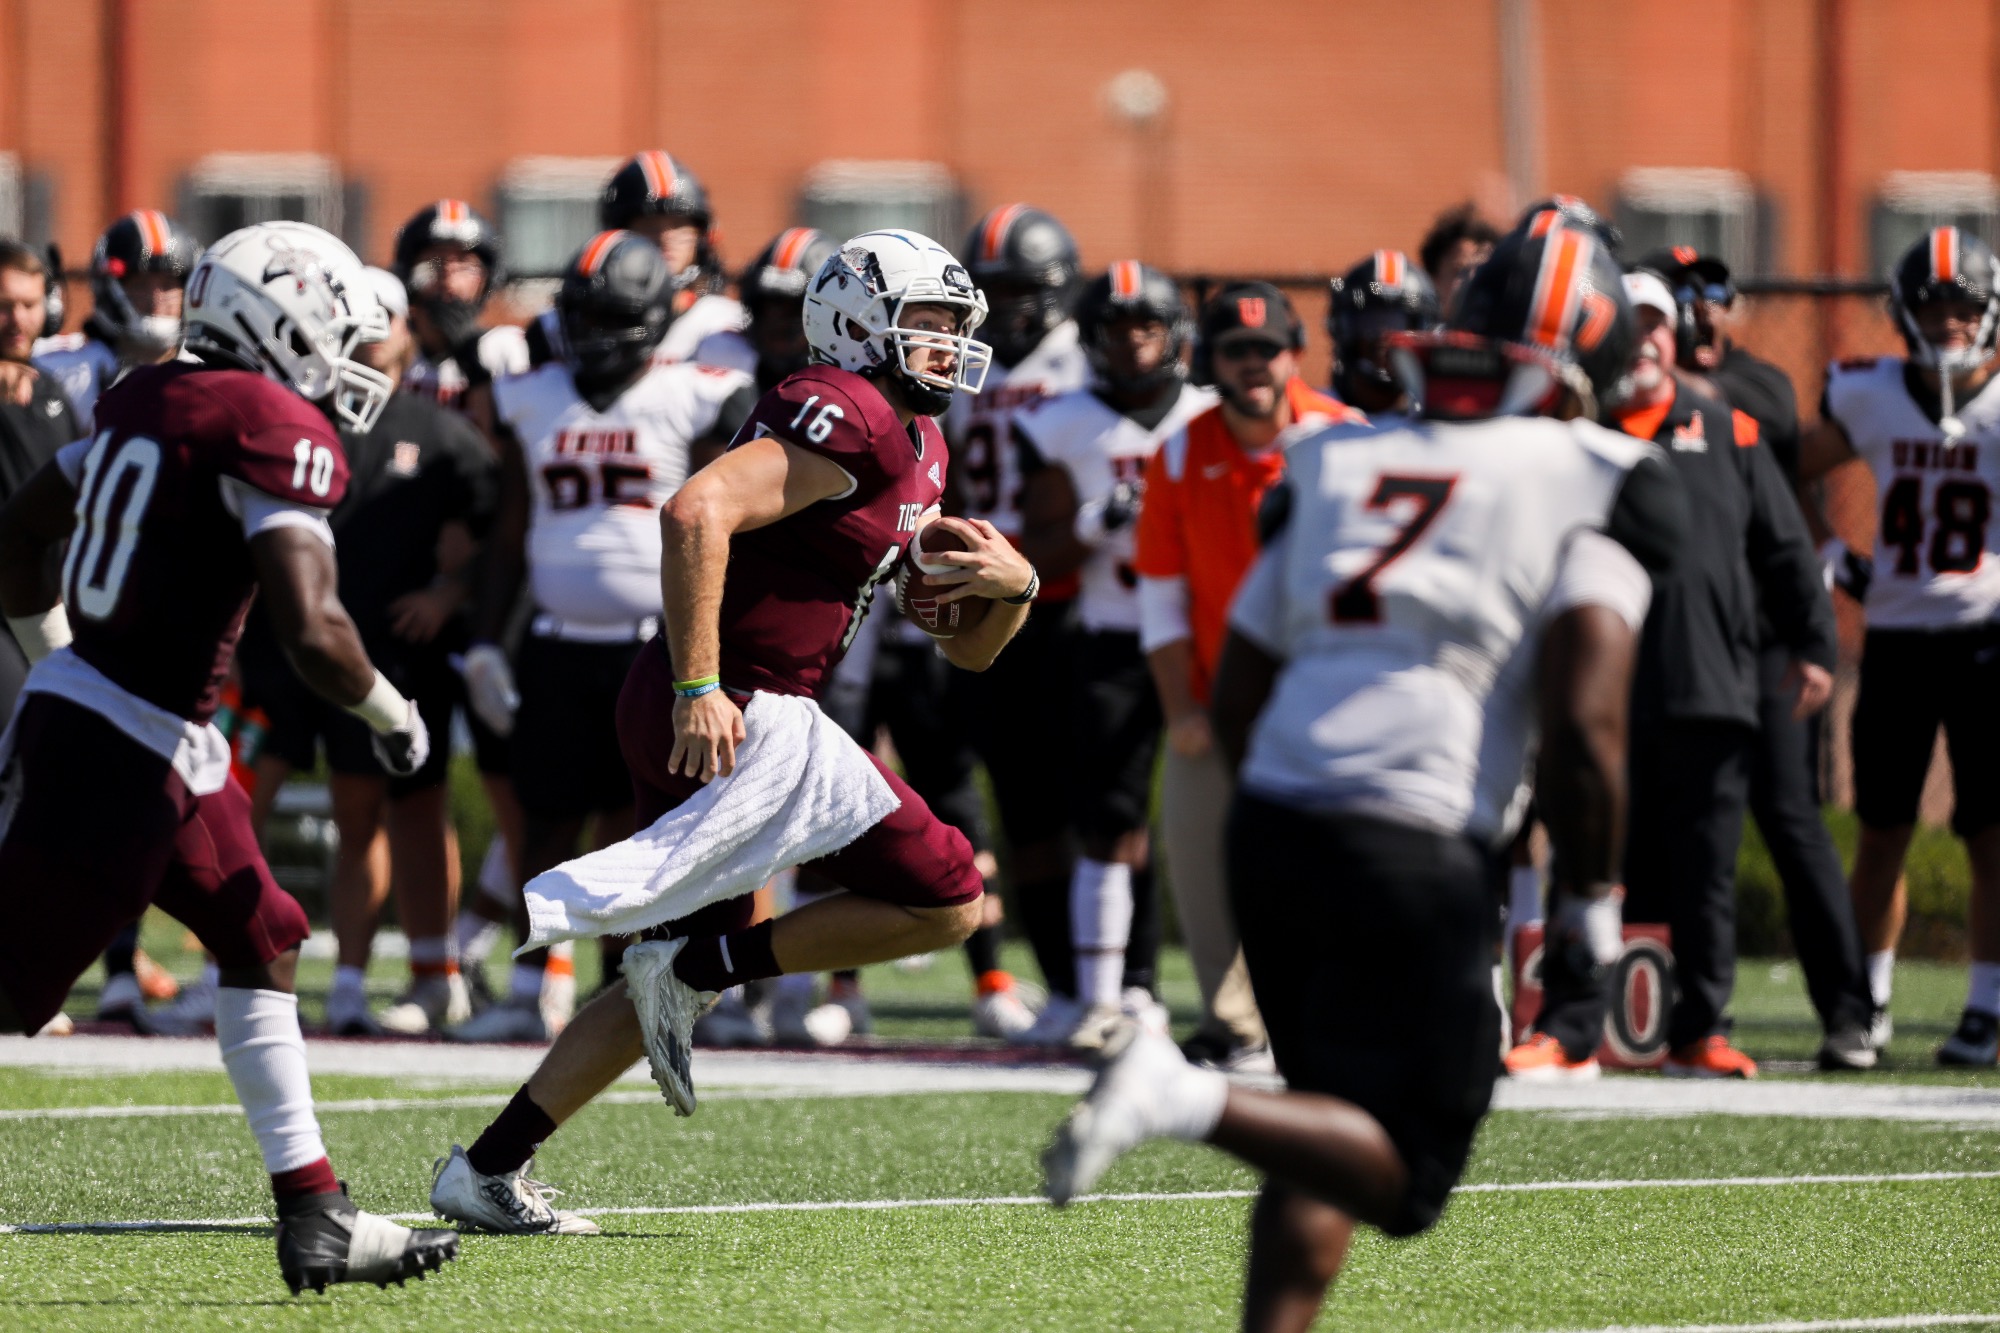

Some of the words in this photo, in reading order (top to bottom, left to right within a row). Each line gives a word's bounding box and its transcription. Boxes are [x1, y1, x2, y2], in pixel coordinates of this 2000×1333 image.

[1237, 297, 1266, 329] U
[790, 395, 844, 444] 16
[292, 438, 335, 498] 10
[1893, 440, 1979, 472] UNION
[62, 428, 161, 621] 10
[1328, 470, 1460, 625] 7
[1882, 476, 1991, 577] 48
